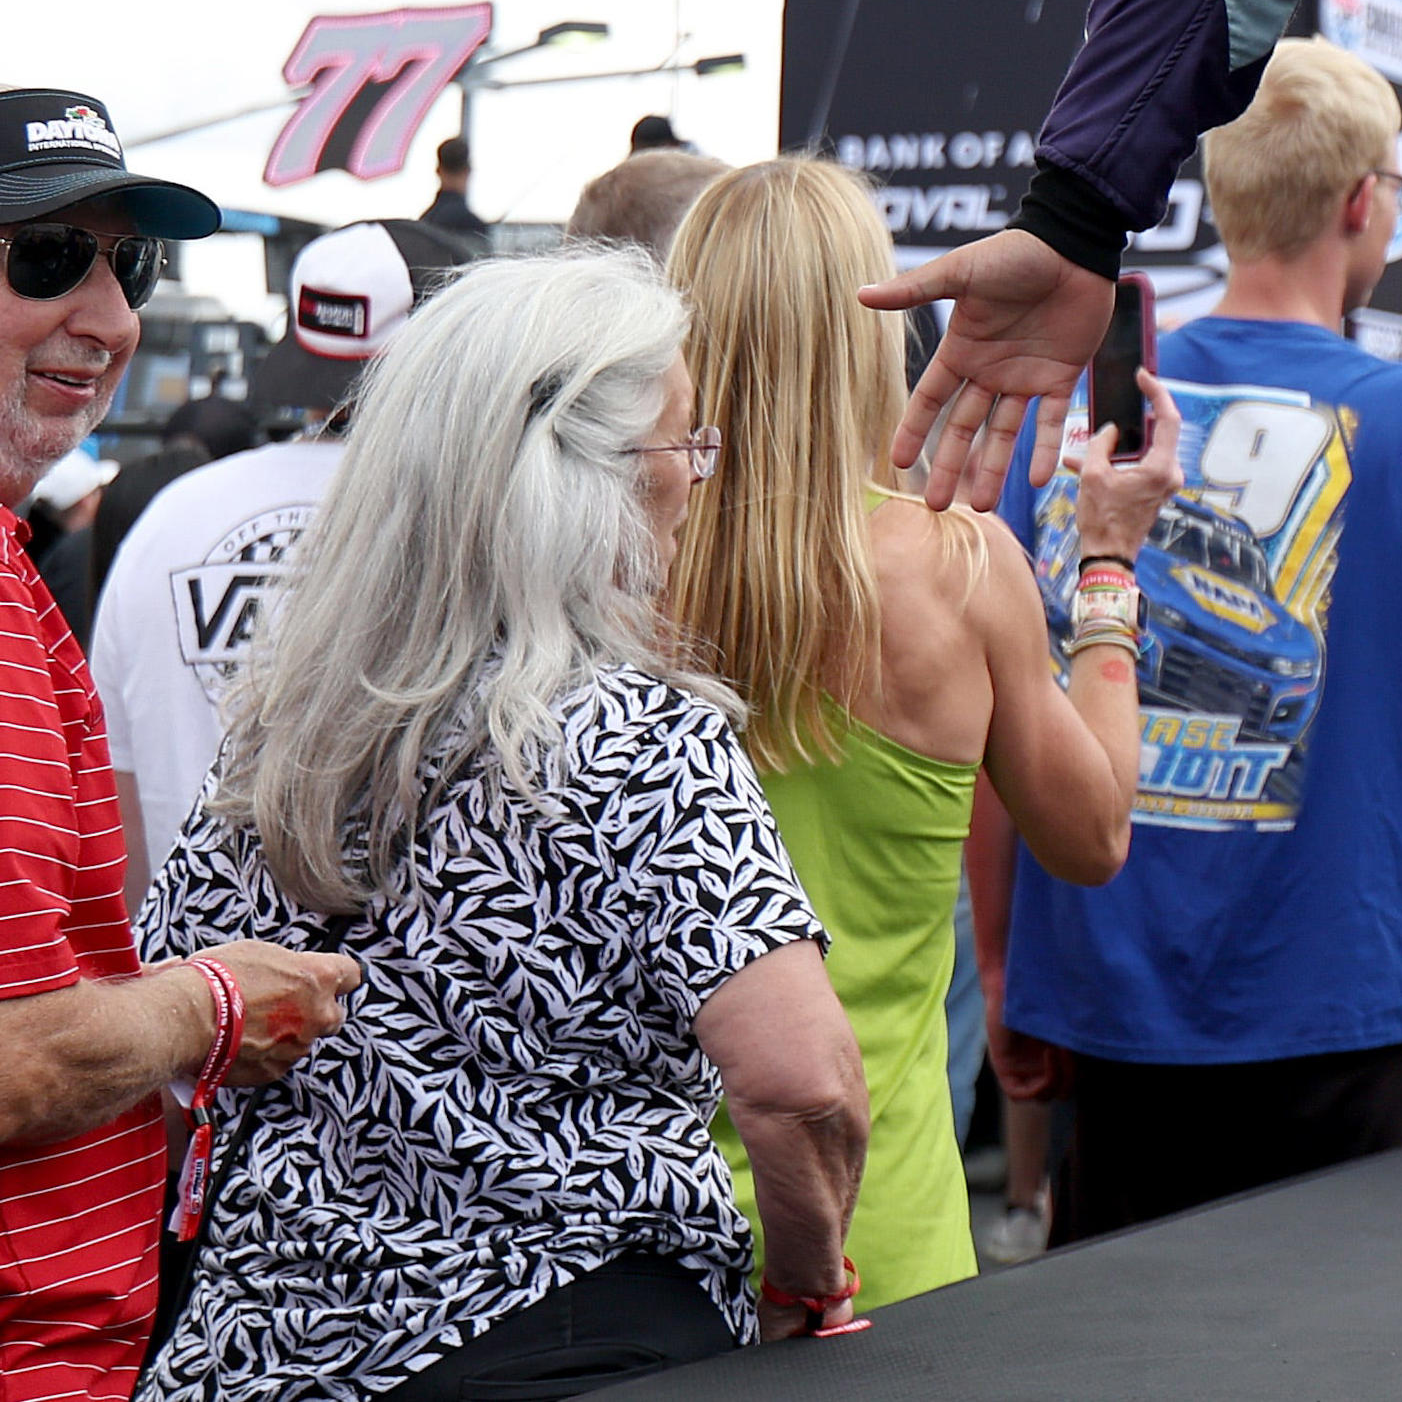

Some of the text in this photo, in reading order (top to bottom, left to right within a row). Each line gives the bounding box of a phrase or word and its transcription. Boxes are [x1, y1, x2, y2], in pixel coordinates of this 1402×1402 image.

[262, 1, 494, 188] 77
[838, 131, 948, 171] BANK
[949, 130, 1003, 170] OF
[872, 184, 1010, 233] OVAL
[1200, 399, 1334, 539] 9
[223, 518, 262, 554] OFF
[1139, 714, 1236, 751] ASE
